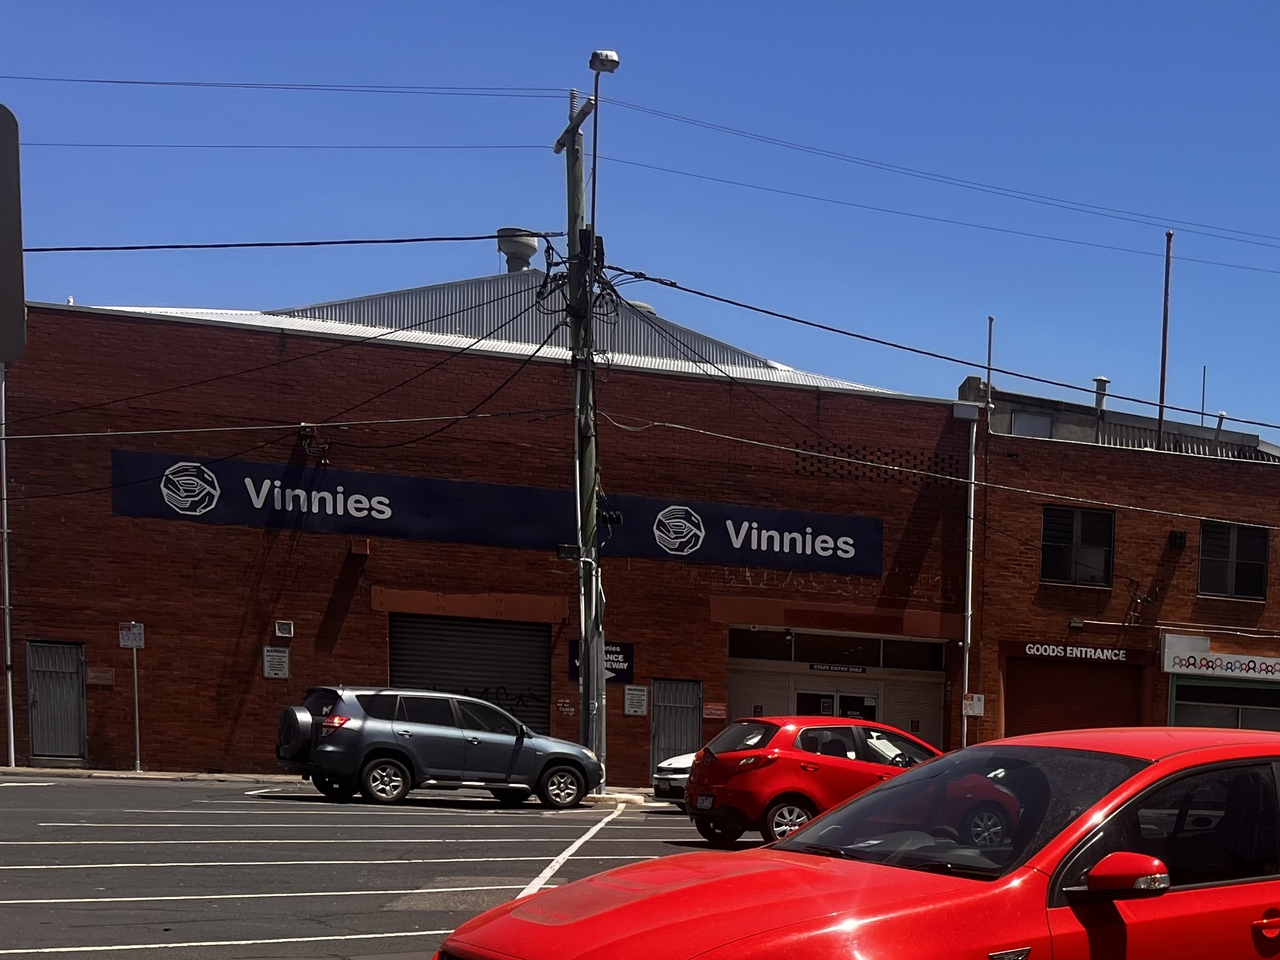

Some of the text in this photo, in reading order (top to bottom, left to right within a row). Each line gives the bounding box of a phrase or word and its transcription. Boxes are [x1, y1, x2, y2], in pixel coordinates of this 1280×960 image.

[244, 477, 393, 520] Vinnies
[725, 519, 855, 559] Vinnies
[1025, 643, 1127, 662] GOODS ENTRANCE
